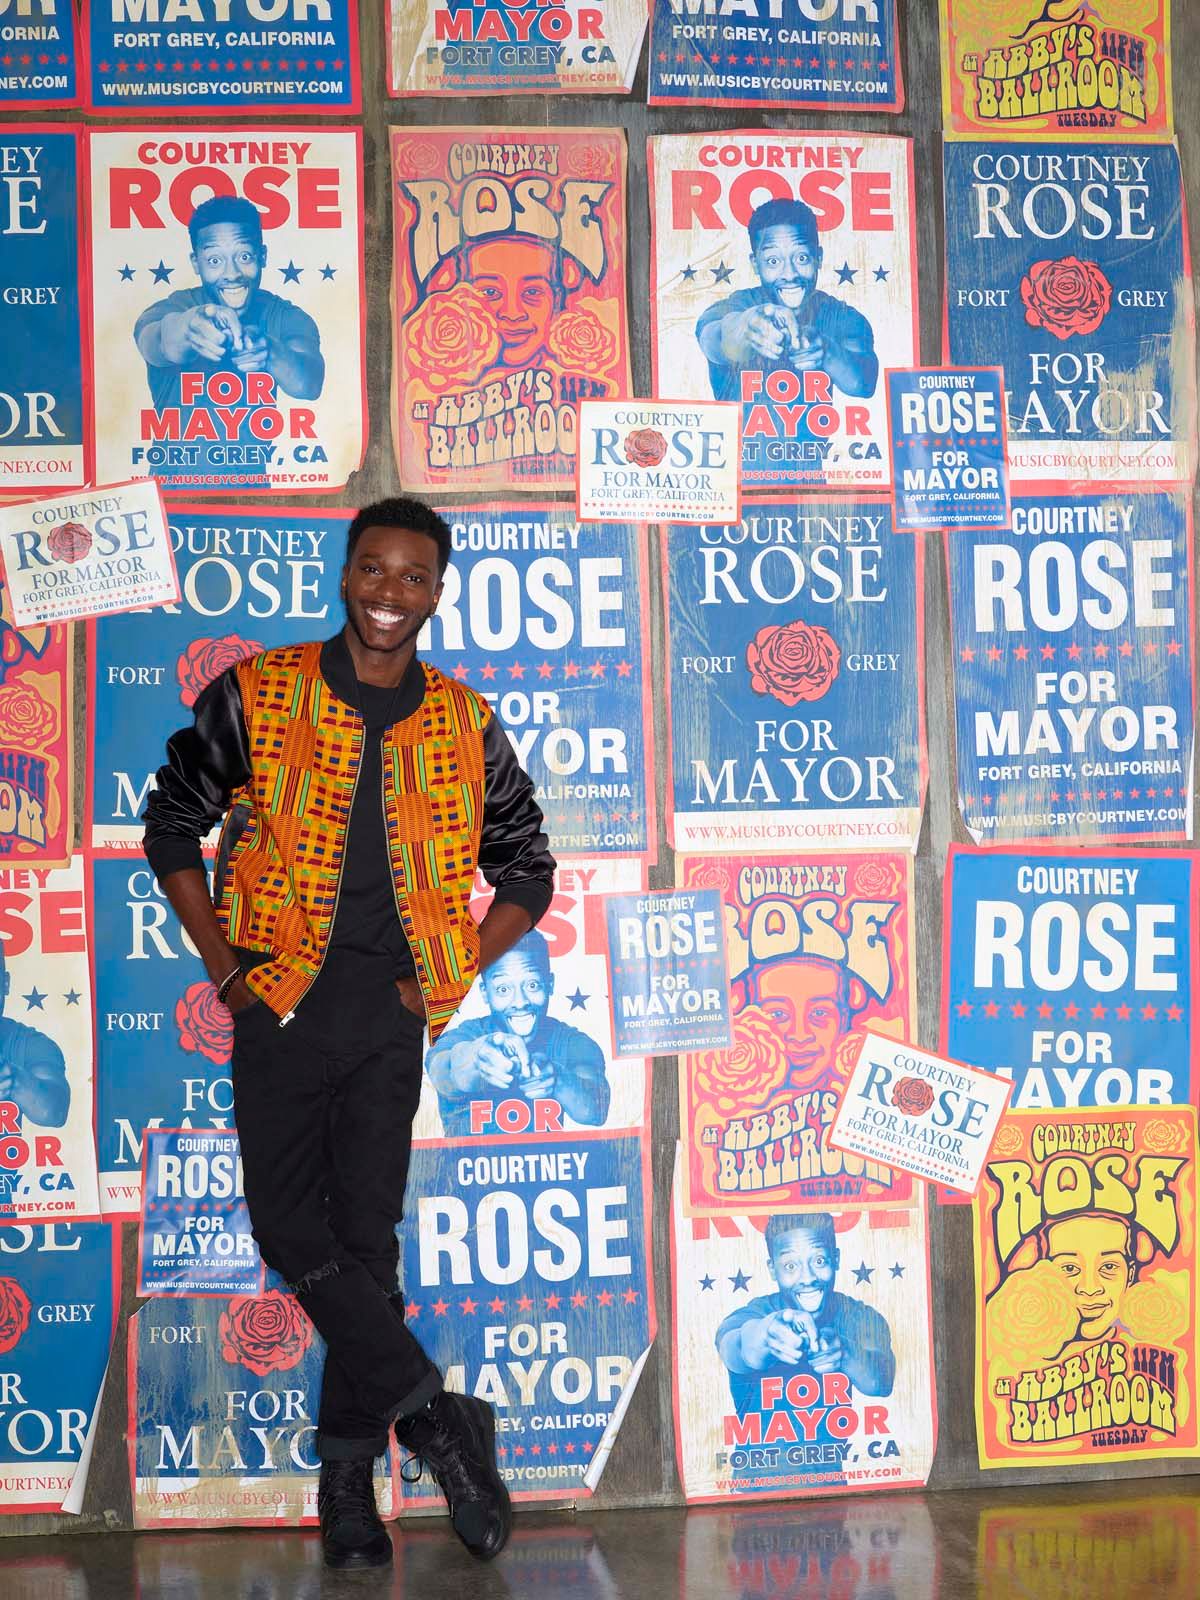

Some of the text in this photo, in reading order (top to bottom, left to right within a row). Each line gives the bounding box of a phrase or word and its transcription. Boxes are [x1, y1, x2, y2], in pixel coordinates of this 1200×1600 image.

[114, 31, 336, 49] FORT GREY, CALIFORNIA
[434, 9, 605, 41] MAYOR
[672, 25, 881, 47] FORT GREY, CALIFORNIA
[427, 46, 616, 66] FORT GREY, CA
[984, 24, 1094, 79] ABBY'S
[1101, 31, 1145, 75] 11PM
[103, 81, 343, 96] WWW.MUSICBYCOURTNEY.COM
[660, 74, 888, 94] WWW.MUSICBYCOURTNEY.COM
[977, 58, 1146, 123] BALLROOM
[1057, 113, 1116, 127] TUESDAY
[137, 142, 312, 165] COURTNEY
[448, 143, 560, 182] COURTNEY
[698, 145, 864, 168] COURTNEY
[973, 154, 1150, 182] COURTNEY
[109, 166, 342, 230] ROSE
[671, 169, 894, 232] ROSE
[973, 183, 1154, 240] ROSE
[398, 177, 615, 286] ROSE
[3, 287, 61, 305] GREY
[958, 290, 1168, 307] FORT GREY
[919, 375, 976, 389] COURTNEY
[1029, 352, 1109, 385] FOR
[180, 372, 278, 406] FOR
[435, 369, 554, 427] ABBY'S
[560, 375, 606, 401] 11PM
[741, 370, 832, 403] FOR
[139, 408, 319, 442] MAYOR
[614, 411, 703, 426] COURTNEY
[743, 405, 872, 438] AYOR
[901, 391, 996, 434] ROSE
[1006, 389, 1171, 434] AYOR
[427, 403, 577, 468] BALLROO
[131, 445, 329, 467] FORT GREY, CA
[766, 441, 840, 463] GREY,
[848, 442, 882, 460] CA
[932, 451, 969, 467] FOR
[603, 471, 712, 489] FOR MAYOR
[903, 467, 999, 490] MAYOR
[591, 488, 621, 498] FORT
[656, 490, 725, 502] CALIFORNIA
[904, 493, 926, 502] FORT
[954, 491, 1000, 501] CALIFORNIA
[32, 500, 119, 525] COURTNEY
[1011, 505, 1134, 535] COURTNEY
[451, 522, 582, 551] COURTNEY
[700, 516, 884, 544] COURTNEY
[23, 589, 55, 604] FORT
[90, 570, 161, 593] CALIFORNIA
[32, 556, 146, 590] FOR MAYOR
[699, 546, 888, 604] ROSE
[974, 540, 1175, 632] ROSE
[416, 557, 626, 651] ROSE
[108, 667, 165, 684] FORT
[682, 654, 901, 674] FORT GREY
[1036, 671, 1117, 704] FOR
[756, 720, 838, 752] FOR
[975, 706, 1179, 757] MAYOR
[505, 728, 629, 776] YOR
[690, 757, 904, 804] MAYOR
[978, 760, 1182, 780] FORT GREY, CALIFORNIA
[534, 784, 632, 800] ALIFORNIA
[685, 823, 911, 839] WWW.MUSICBYCOURTNEY.COM
[739, 865, 848, 905] COURTNEY
[1017, 866, 1139, 895] COURTNEY
[637, 896, 695, 914] COURTNEY
[618, 911, 718, 960] ROSE
[974, 900, 1178, 992] ROSE
[651, 974, 690, 992] FOR
[622, 988, 721, 1018] MAYOR
[106, 1013, 164, 1031] FORT
[624, 1019, 648, 1029] FORT
[674, 1013, 723, 1025] CALIFORNIA
[1032, 1030, 1112, 1064] FOR
[893, 1054, 976, 1092] COURTNEY
[470, 1098, 564, 1134] FOR
[723, 1089, 838, 1151] ABBY'S
[862, 1106, 963, 1156] FOR MAYOR
[177, 1138, 239, 1152] COURTNEY
[847, 1118, 877, 1138] FORT
[907, 1141, 970, 1170] CALIFORNIA
[1031, 1122, 1137, 1163] COURTNEY
[458, 1152, 588, 1186] COURTNEY
[849, 1142, 955, 1183] WWW.MUSICBYCOURTNEY.COM
[39, 1173, 75, 1191] CA
[800, 1181, 862, 1198] TUESDAY
[184, 1216, 225, 1232] FOR
[987, 1154, 1189, 1268] ROSE
[153, 1234, 255, 1256] MAYOR
[418, 1185, 632, 1287] ROSE
[153, 1259, 175, 1268] FORT
[204, 1259, 255, 1268] CALIFORNIA
[146, 1281, 257, 1290] WWW.MUSICBYCOURTNEY.COM
[37, 1304, 95, 1322] GREY
[150, 1326, 206, 1345] FORT
[484, 1321, 568, 1359] FOR
[1015, 1340, 1127, 1402] ABBY'S
[1133, 1347, 1174, 1394] 11PM
[224, 1389, 310, 1421] FOR
[761, 1372, 852, 1410] FOR
[1010, 1374, 1176, 1442] BALLROOM
[723, 1405, 891, 1446] MAYOR
[1091, 1430, 1148, 1447] TUESDAY
[716, 1440, 901, 1470] FORT GREY, CA
[716, 1467, 902, 1490] WWW.MUSICBYCOURTNEY.COM
